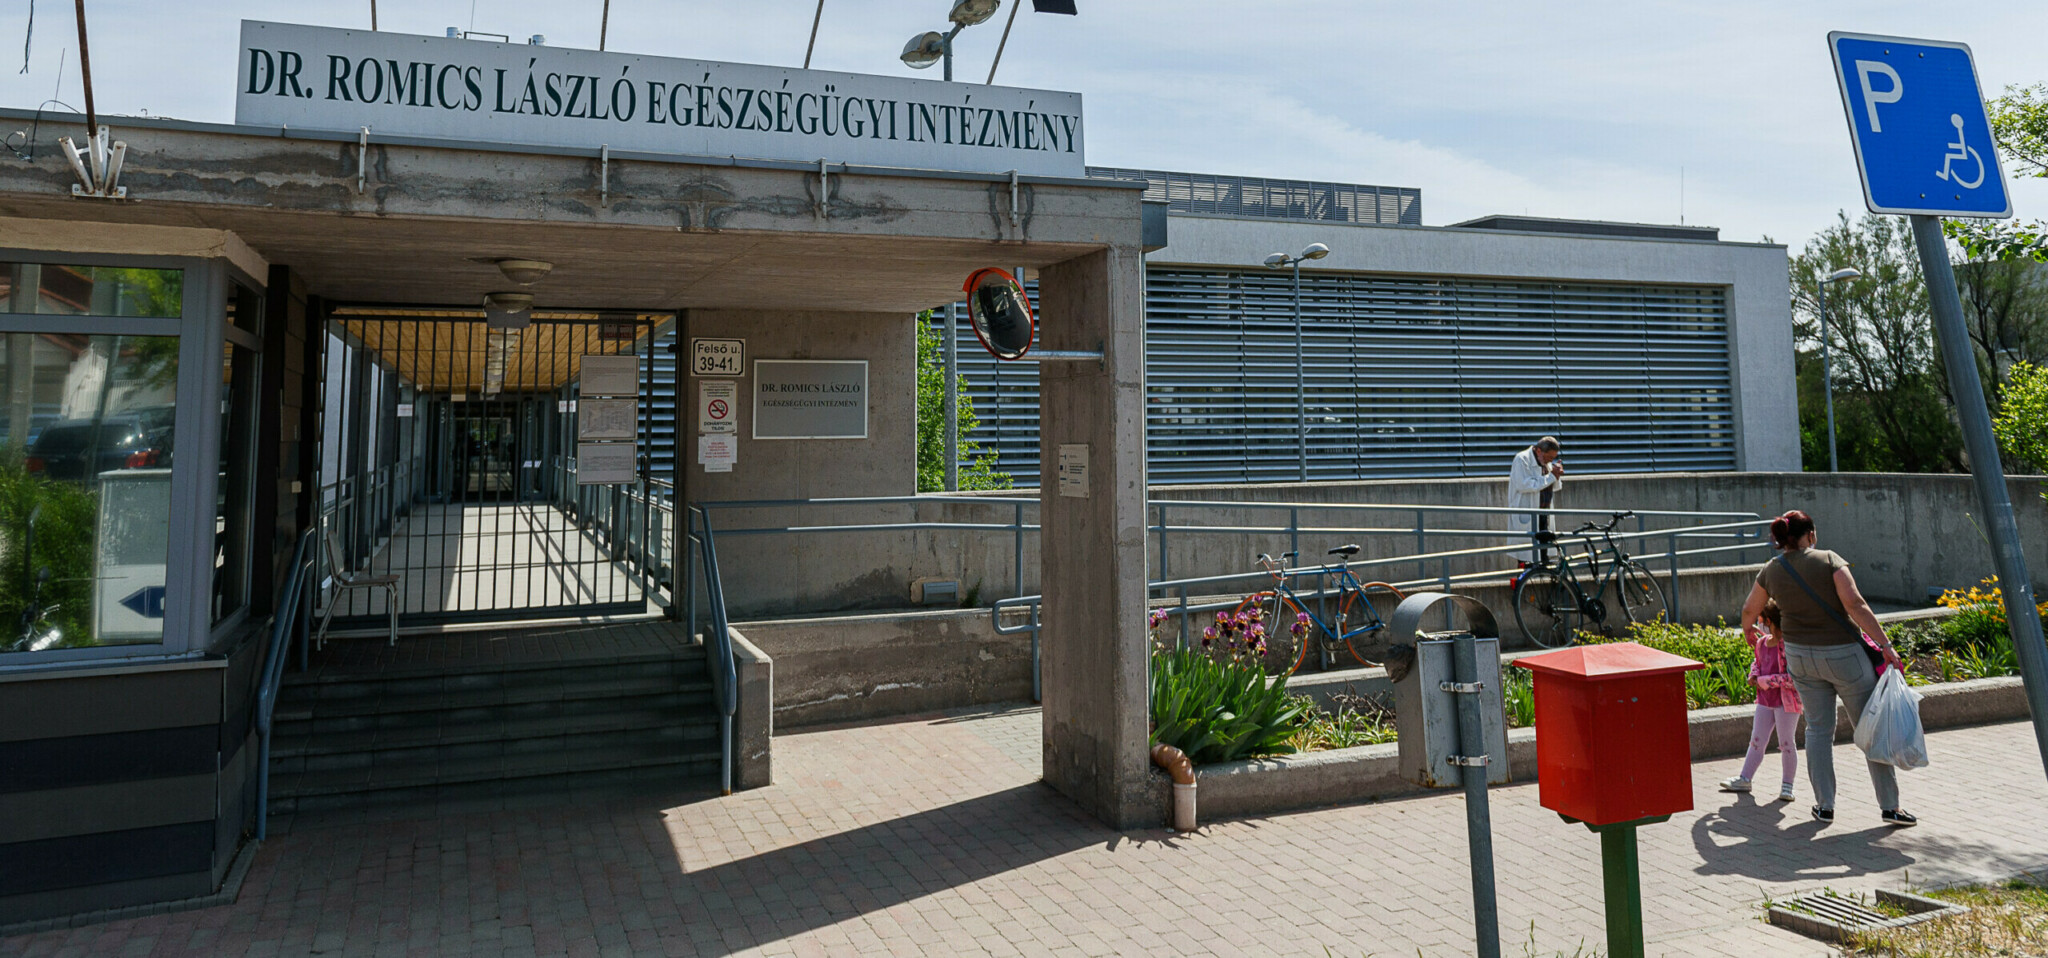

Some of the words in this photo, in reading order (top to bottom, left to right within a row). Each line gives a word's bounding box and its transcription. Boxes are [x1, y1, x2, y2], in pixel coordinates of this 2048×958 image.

[245, 48, 313, 99] DR.
[325, 54, 483, 112] ROMICS
[492, 57, 637, 122] LÁSZLÓ
[646, 73, 898, 140] EGÉSZSÉGÜGYI
[906, 95, 1079, 153] INTÉZMÉNY
[1855, 59, 1904, 133] P
[697, 343, 728, 354] Felső
[731, 346, 740, 354] u.
[700, 356, 737, 371] 39-41.
[761, 383, 778, 393] DR.
[780, 383, 820, 393] ROMICS
[822, 382, 860, 393] LÁSZLÓ
[763, 399, 817, 407] EGÉSZSÉGÜGYI
[818, 399, 858, 407] INTÉZMÉNY
